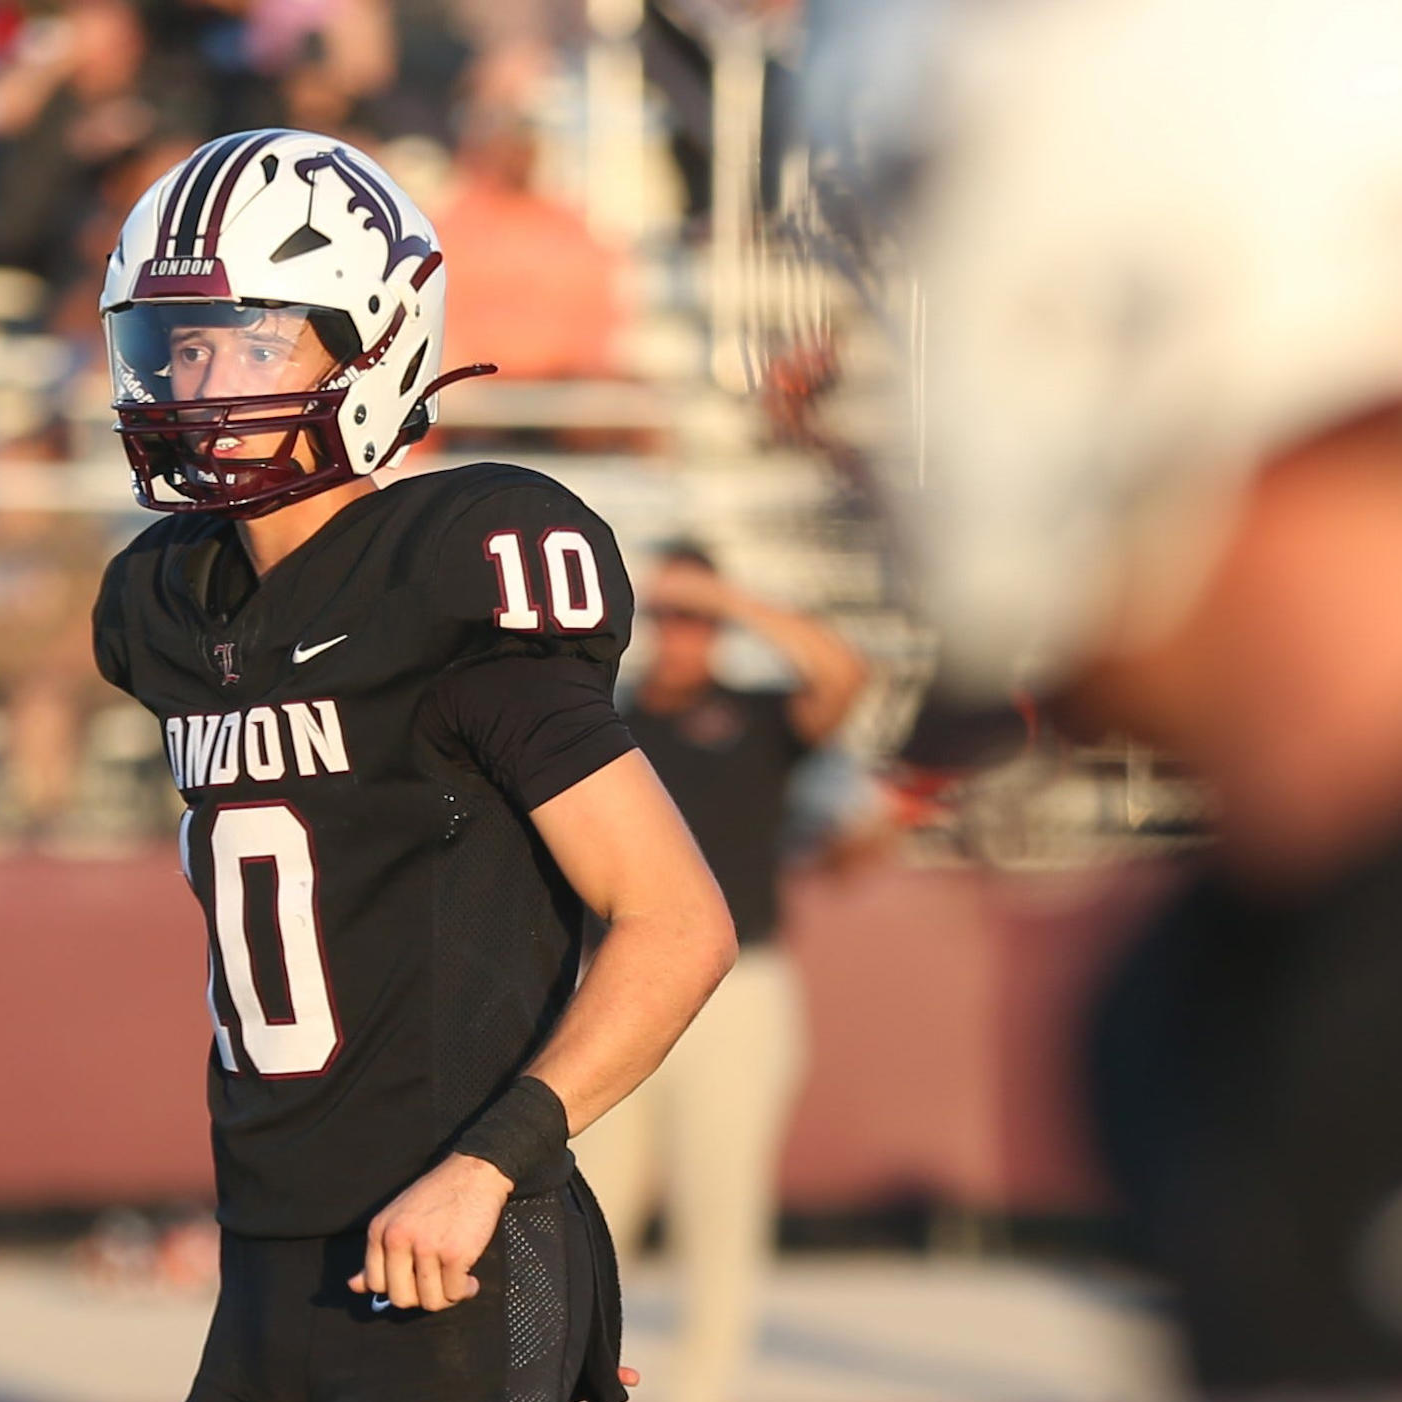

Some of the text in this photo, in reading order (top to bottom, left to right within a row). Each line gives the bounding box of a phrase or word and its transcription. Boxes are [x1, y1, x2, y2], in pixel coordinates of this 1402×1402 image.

[150, 259, 214, 276] LONDON
[484, 528, 605, 633] 10
[165, 698, 350, 790] ONDON
